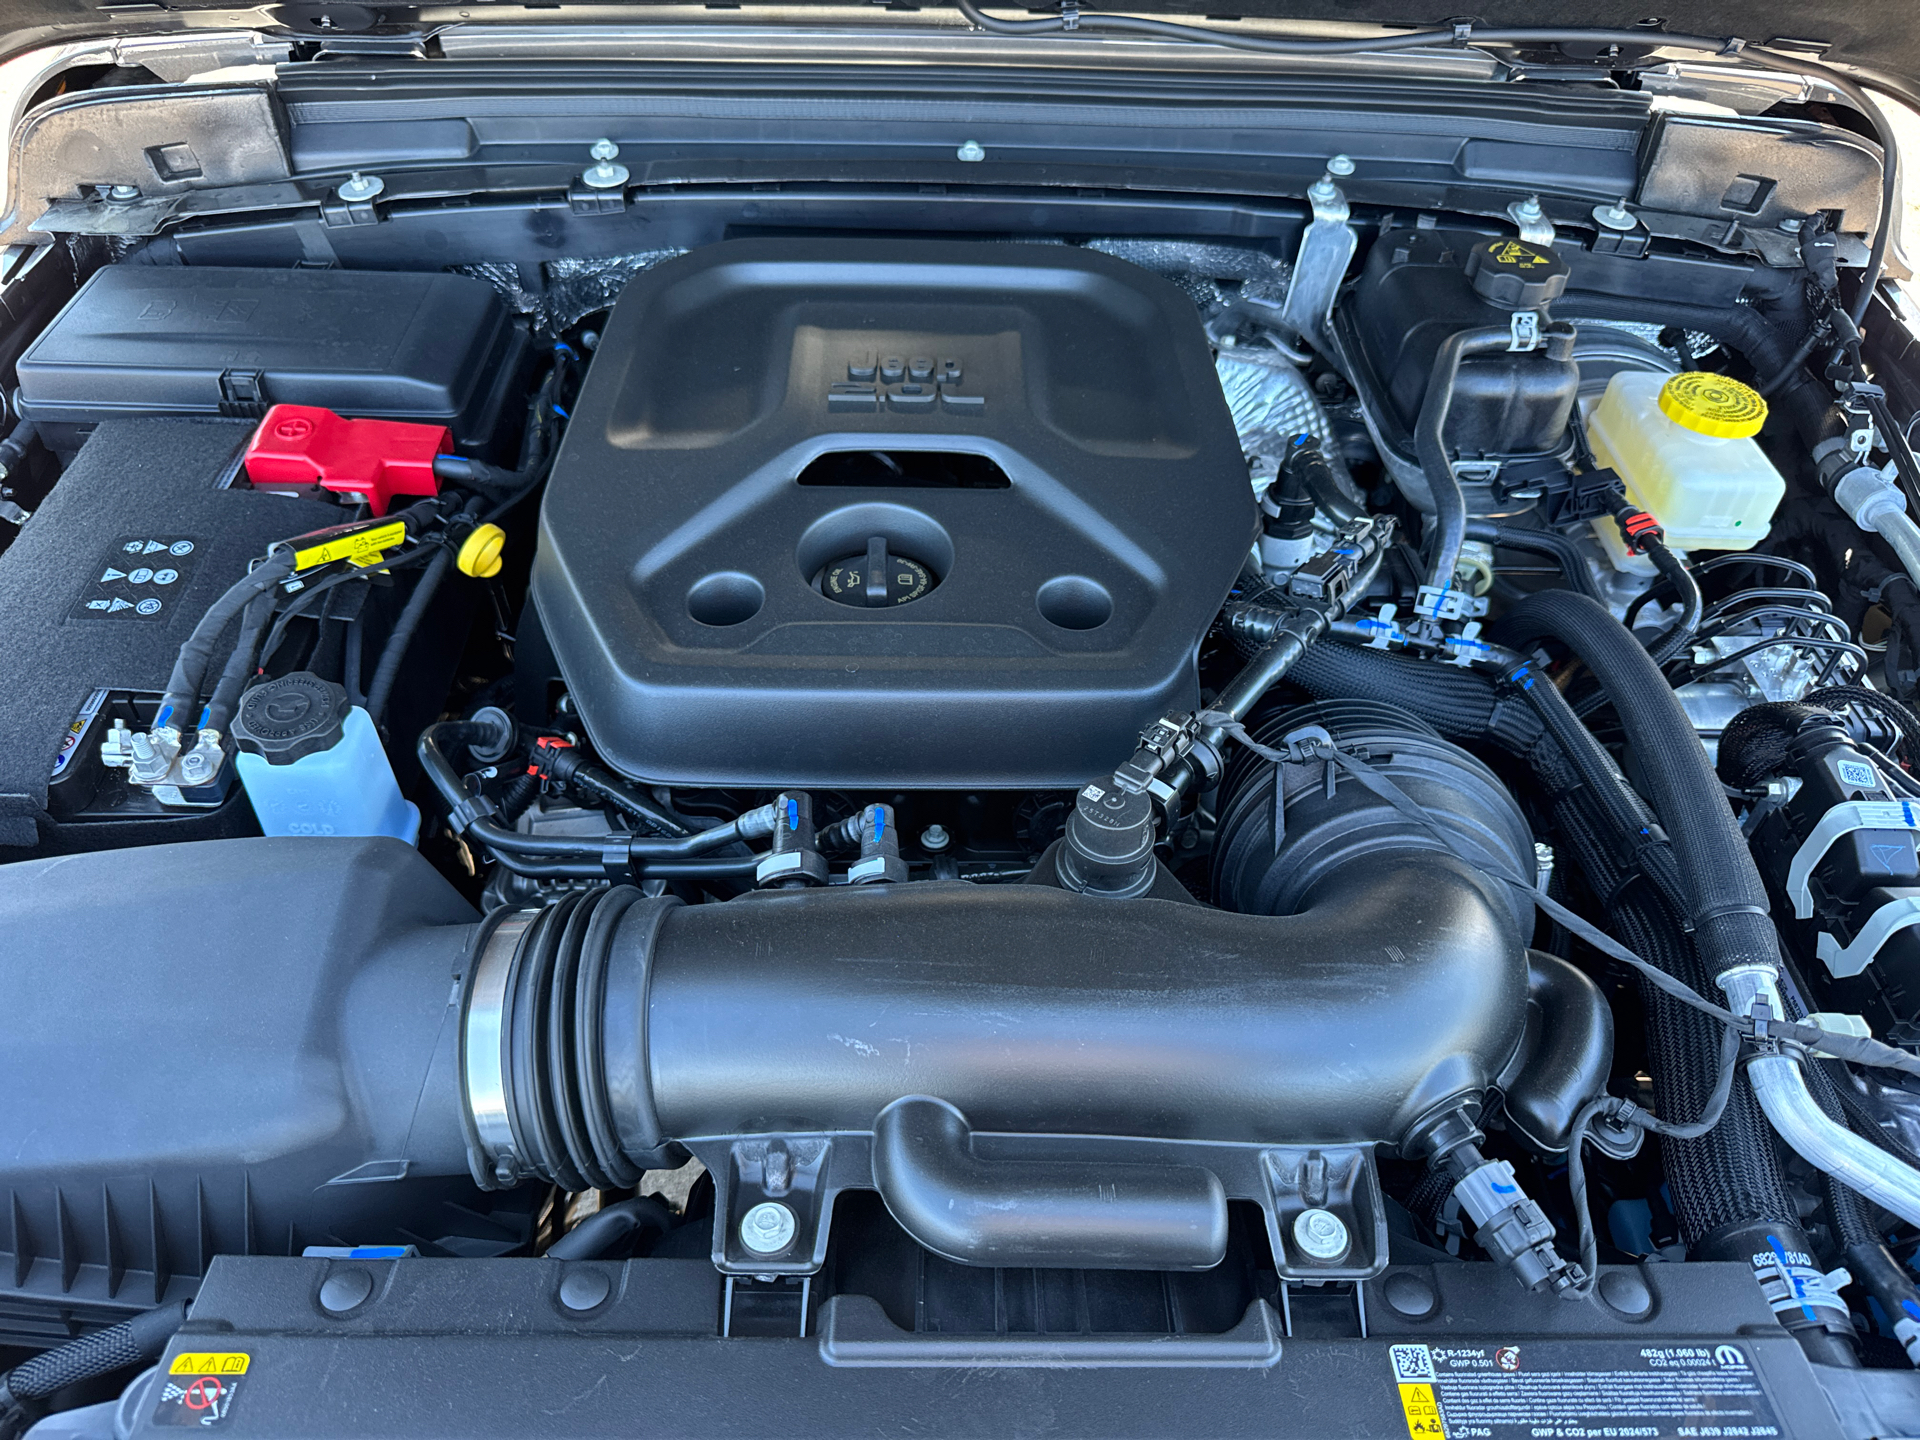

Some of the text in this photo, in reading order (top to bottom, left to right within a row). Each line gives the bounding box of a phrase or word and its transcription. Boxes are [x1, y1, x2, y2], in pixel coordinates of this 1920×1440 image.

[848, 350, 964, 383] Jeep
[827, 382, 985, 405] 2.0L
[830, 568, 844, 594] ENGINE OIL
[897, 596, 912, 604] API
[268, 678, 315, 692] STEERING
[246, 689, 268, 710] FLUID
[248, 717, 318, 737] USE APPROVED
[288, 822, 336, 835] COLD
[1752, 1251, 1812, 1267] 682981AD
[1447, 1350, 1485, 1358] R-1234yf
[1640, 1348, 1710, 1359] 482g (1.060 lb)
[1472, 1359, 1494, 1367] 0.501
[1649, 1359, 1668, 1367] CO2
[1680, 1359, 1710, 1367] 0.00024
[1470, 1428, 1492, 1436] PAG
[1531, 1428, 1554, 1437] GWP
[1565, 1428, 1585, 1437] CO2
[1587, 1430, 1602, 1438] per
[1604, 1428, 1617, 1436] EU
[1619, 1428, 1659, 1436] 2024/573
[1677, 1427, 1697, 1436] SAE
